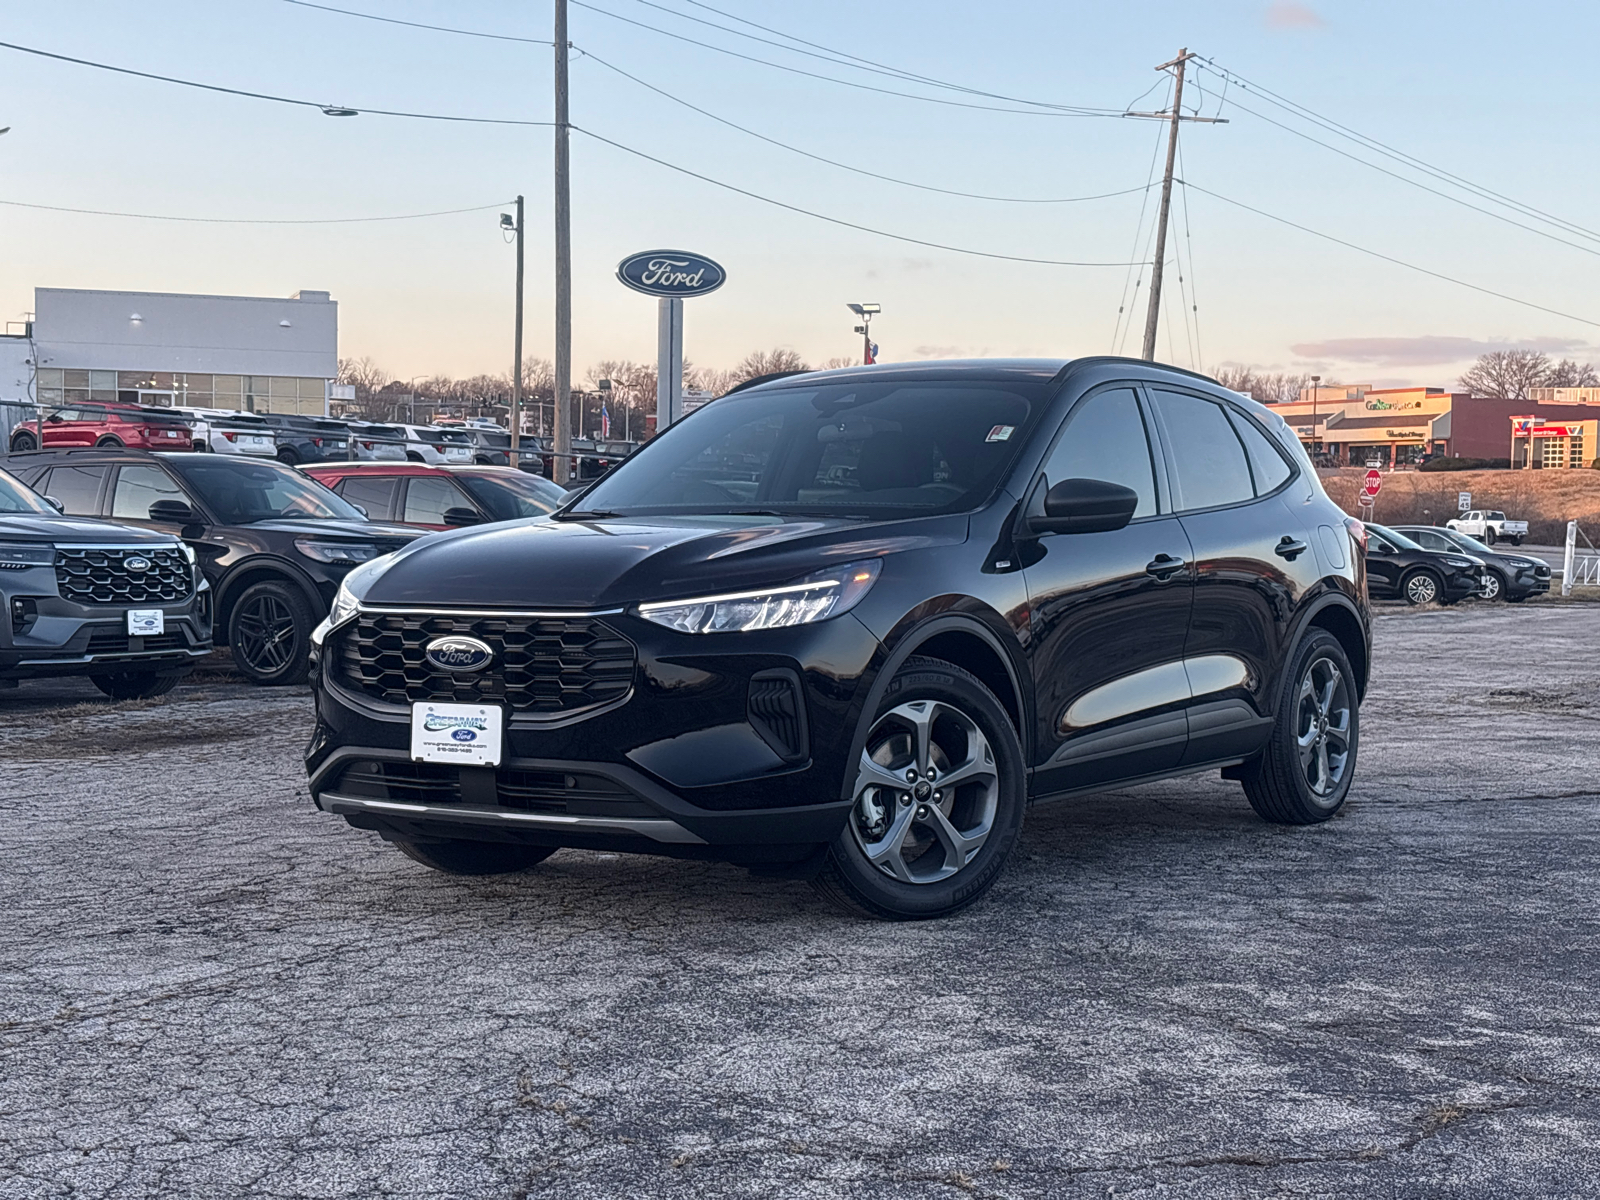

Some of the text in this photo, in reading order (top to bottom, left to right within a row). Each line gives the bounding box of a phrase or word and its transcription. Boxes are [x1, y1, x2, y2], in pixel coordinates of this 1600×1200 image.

[641, 258, 705, 287] Ford
[1365, 477, 1380, 488] STOP
[131, 559, 146, 568] Ford
[439, 643, 474, 664] Ford
[456, 730, 472, 740] Ford
